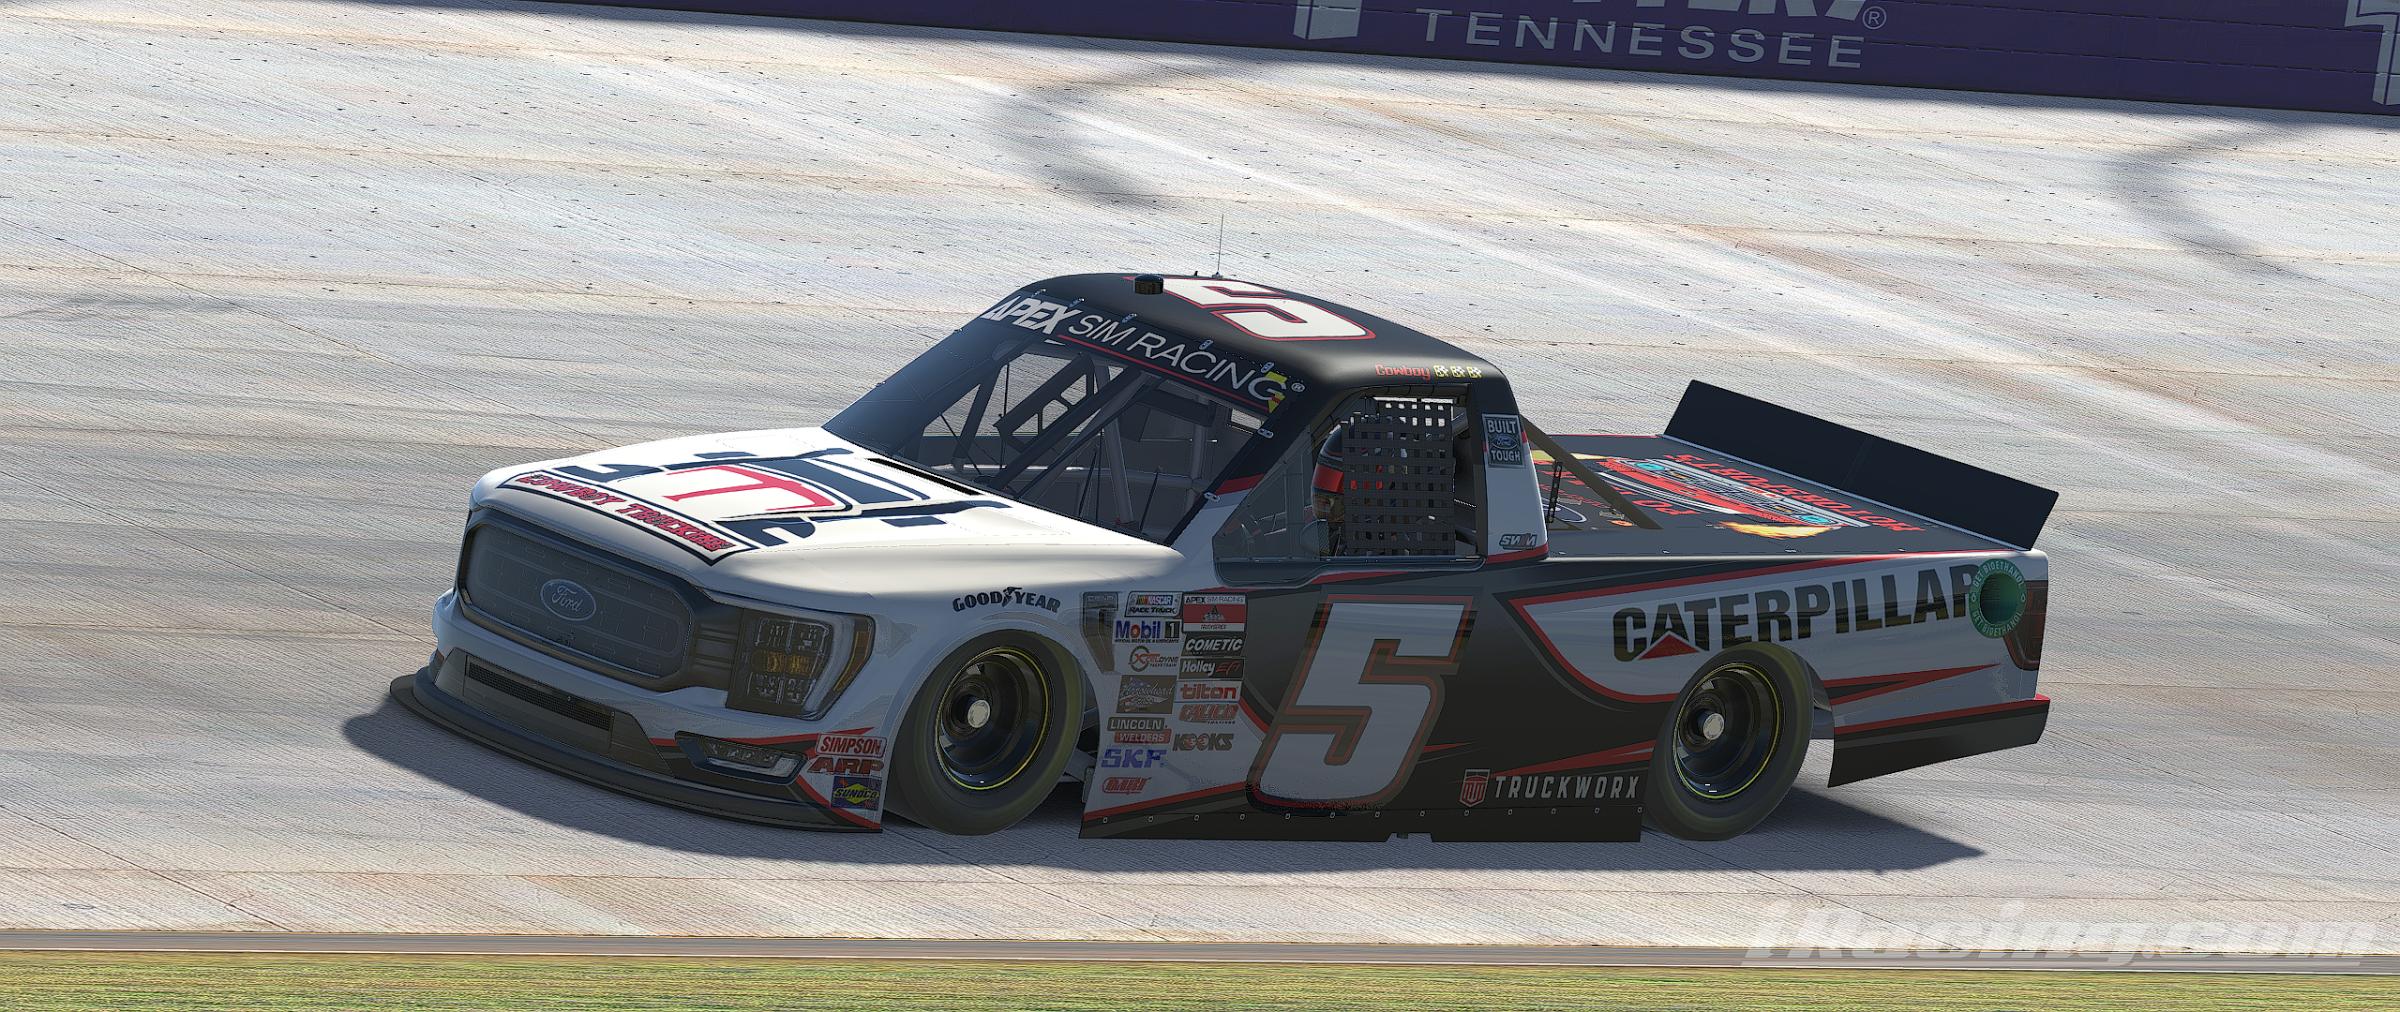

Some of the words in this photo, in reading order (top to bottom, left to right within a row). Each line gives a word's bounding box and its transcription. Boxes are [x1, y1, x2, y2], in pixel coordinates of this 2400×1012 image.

[1416, 7, 1865, 69] TENNESSEE
[981, 295, 1082, 335] APEX
[1068, 314, 1137, 347] SIM
[1126, 331, 1287, 402] RACING
[1375, 363, 1431, 381] Cowboy
[1487, 419, 1516, 433] BUILT
[1490, 450, 1521, 462] TOUGH
[515, 474, 626, 506] COWBOY
[1612, 563, 1980, 663] CATERPILLAR
[1115, 619, 1161, 639] Mobil
[1185, 638, 1243, 652] COMETIC
[1181, 659, 1216, 677] Holley
[1180, 683, 1237, 699] tilton
[1252, 597, 1471, 808] 5
[1110, 719, 1162, 730] LINCOLN
[820, 736, 883, 755] SIMPSON
[1119, 733, 1165, 742] WELDERS
[806, 756, 885, 775] ARP
[1101, 748, 1167, 768] SKF
[834, 787, 878, 799] SUNOCO
[1494, 774, 1640, 799] TRUCKWORX
